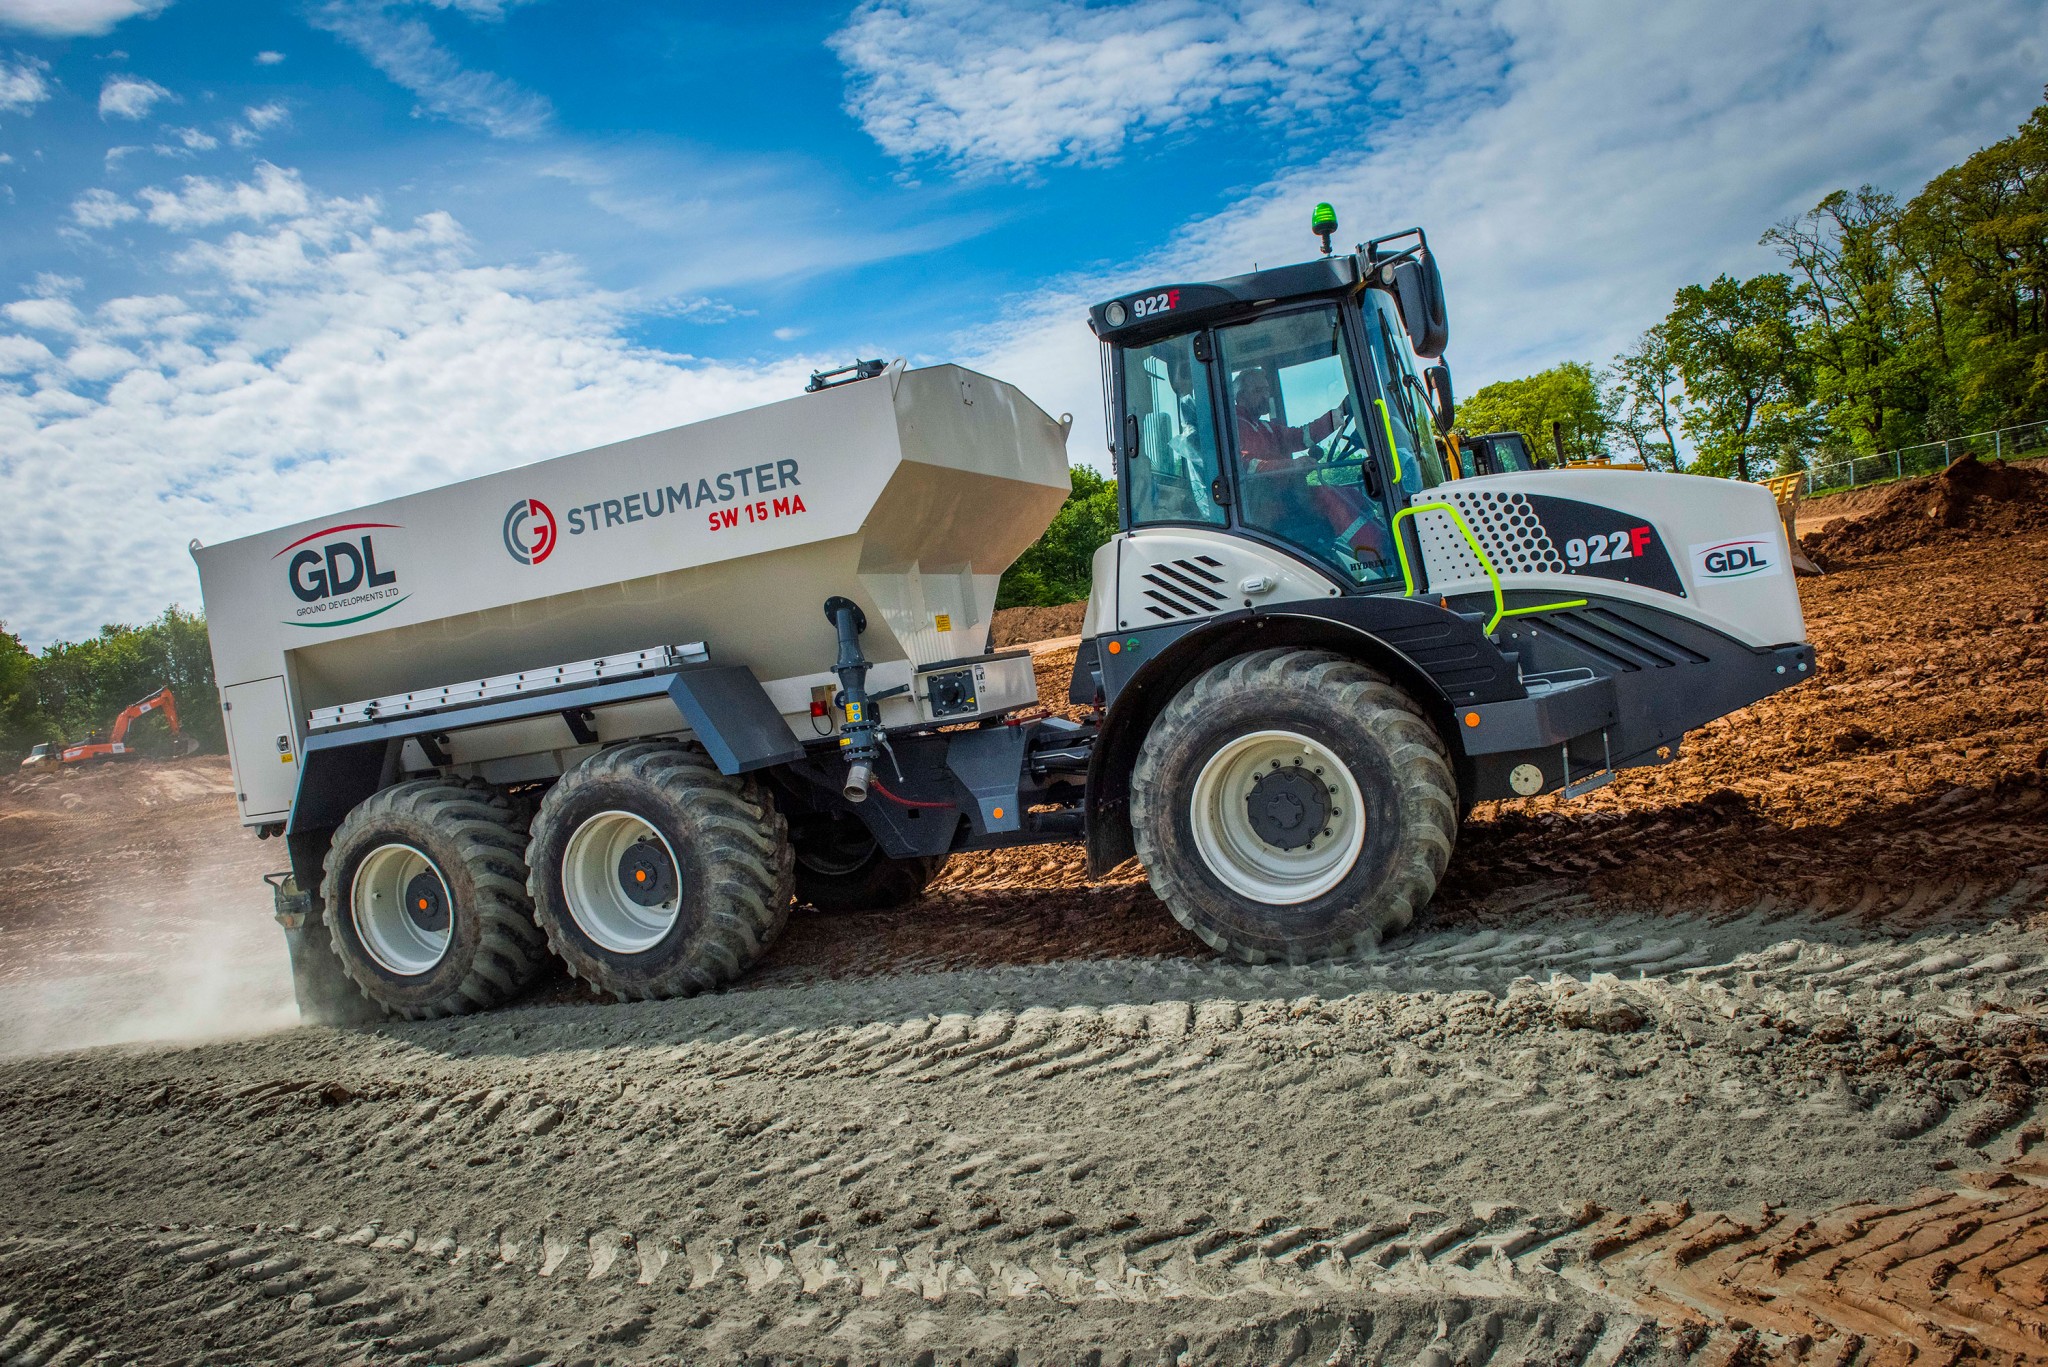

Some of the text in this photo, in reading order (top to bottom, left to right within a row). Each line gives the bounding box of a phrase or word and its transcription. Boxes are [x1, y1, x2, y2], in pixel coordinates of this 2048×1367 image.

[1134, 289, 1180, 318] 922F
[567, 458, 802, 535] STREUMASTER
[708, 494, 806, 531] SW 15 MA
[1565, 526, 1651, 567] 922F
[1704, 546, 1767, 573] GDL
[288, 535, 397, 602] GDL
[296, 587, 399, 616] GROUND DEVELOPMENTS LTD
